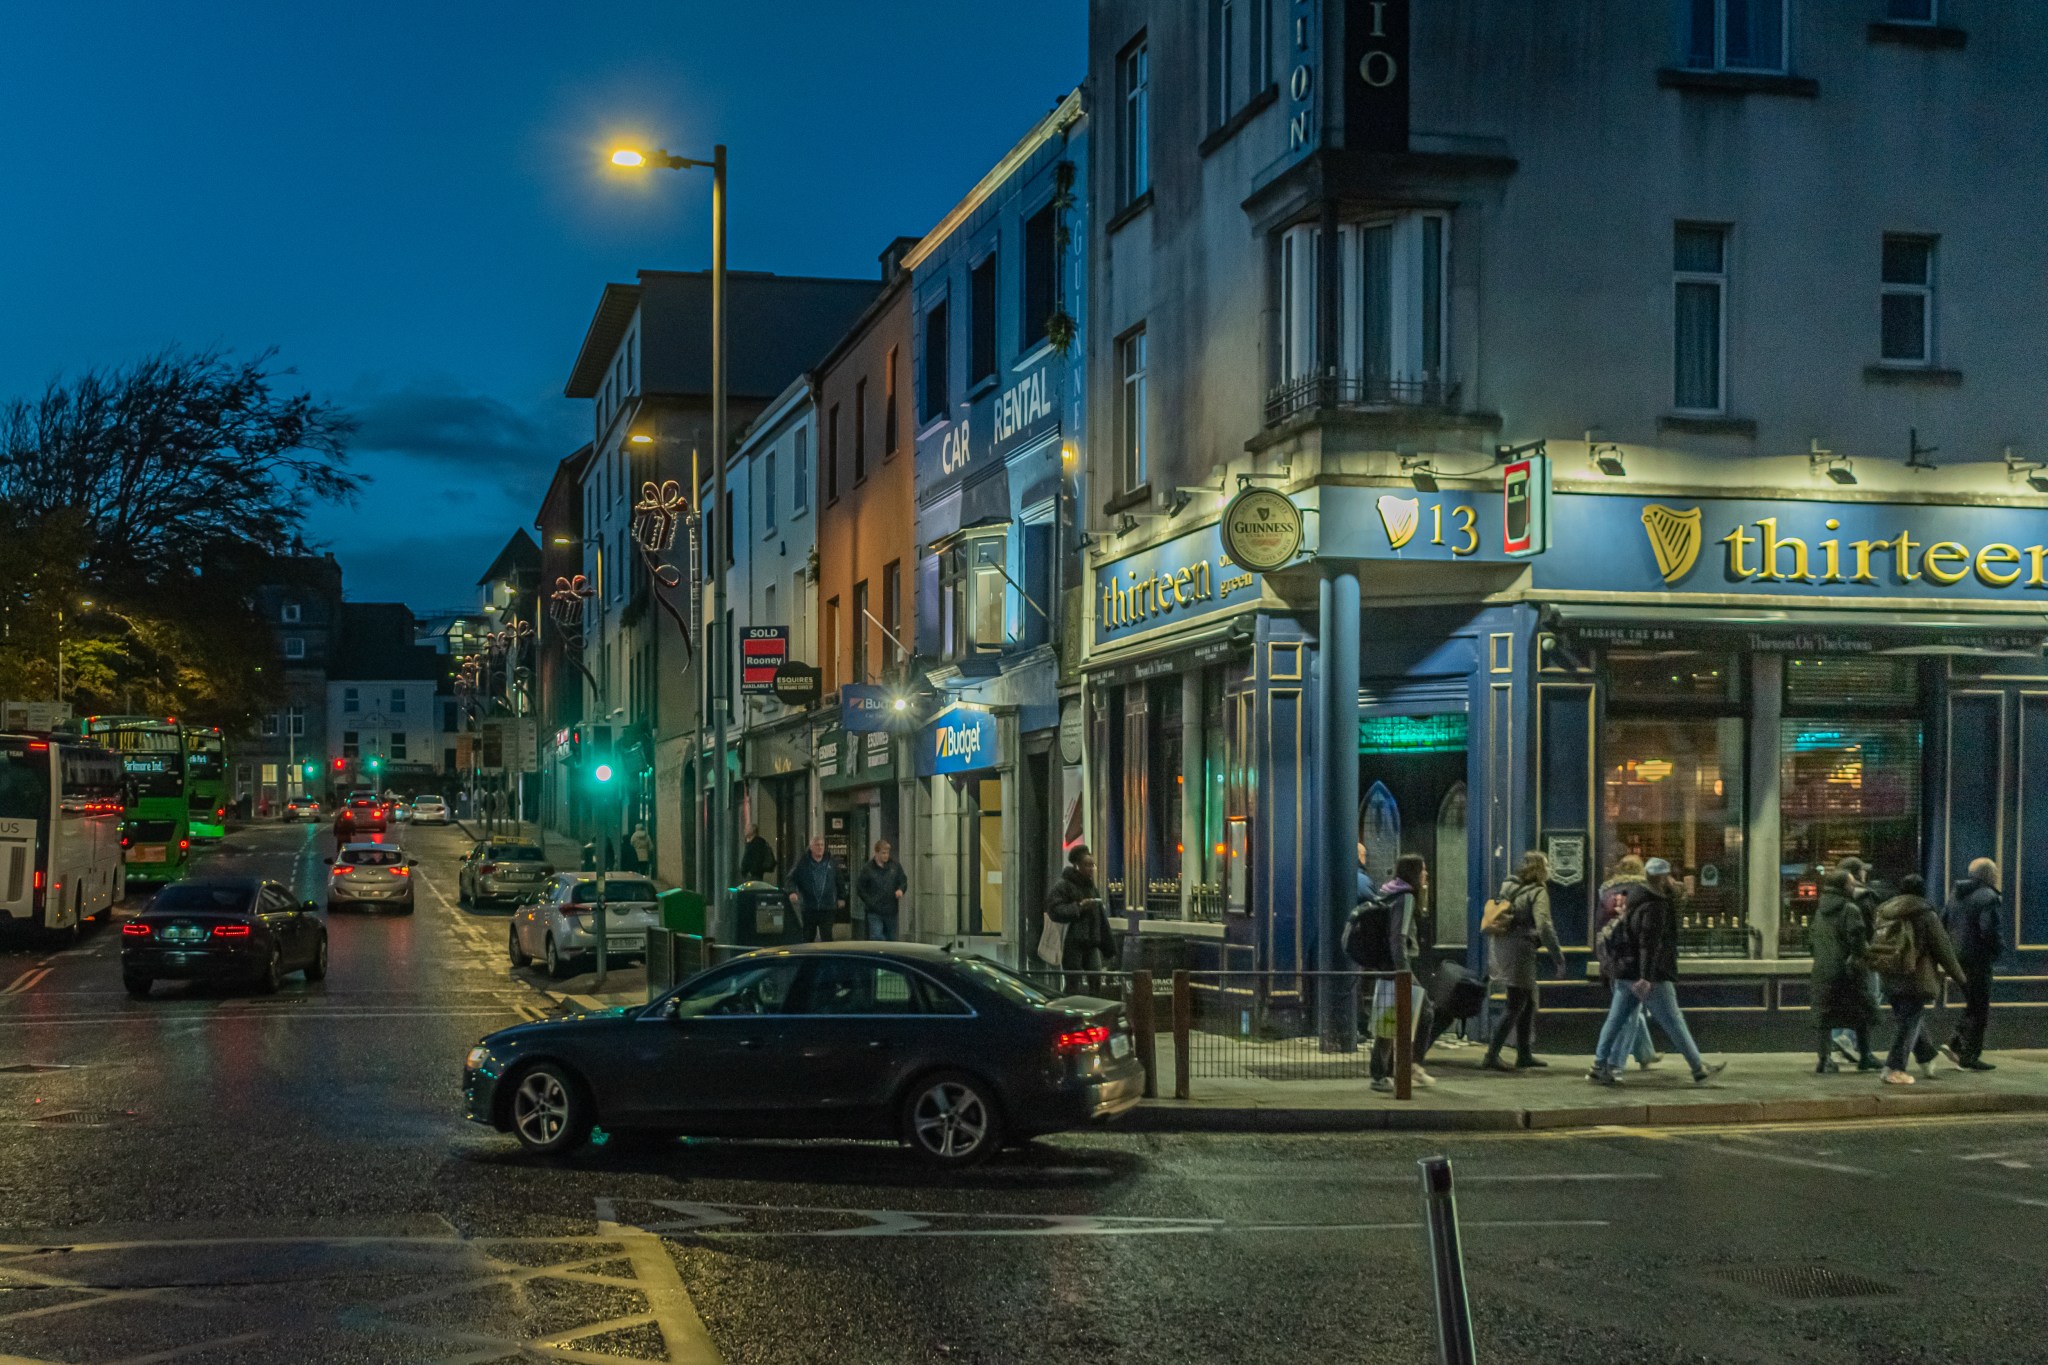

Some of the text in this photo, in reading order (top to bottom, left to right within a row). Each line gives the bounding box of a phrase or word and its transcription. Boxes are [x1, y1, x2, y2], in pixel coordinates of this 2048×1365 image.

[1290, 0, 1307, 149] ION
[942, 367, 1051, 475] CAR RENTAL
[1234, 521, 1294, 534] GUINNESS
[1430, 504, 1479, 555] 13
[1103, 560, 1211, 627] thirteen
[1220, 572, 1253, 598] green
[750, 629, 778, 638] SOLD
[746, 656, 782, 666] Rooney
[947, 721, 981, 764] Budget
